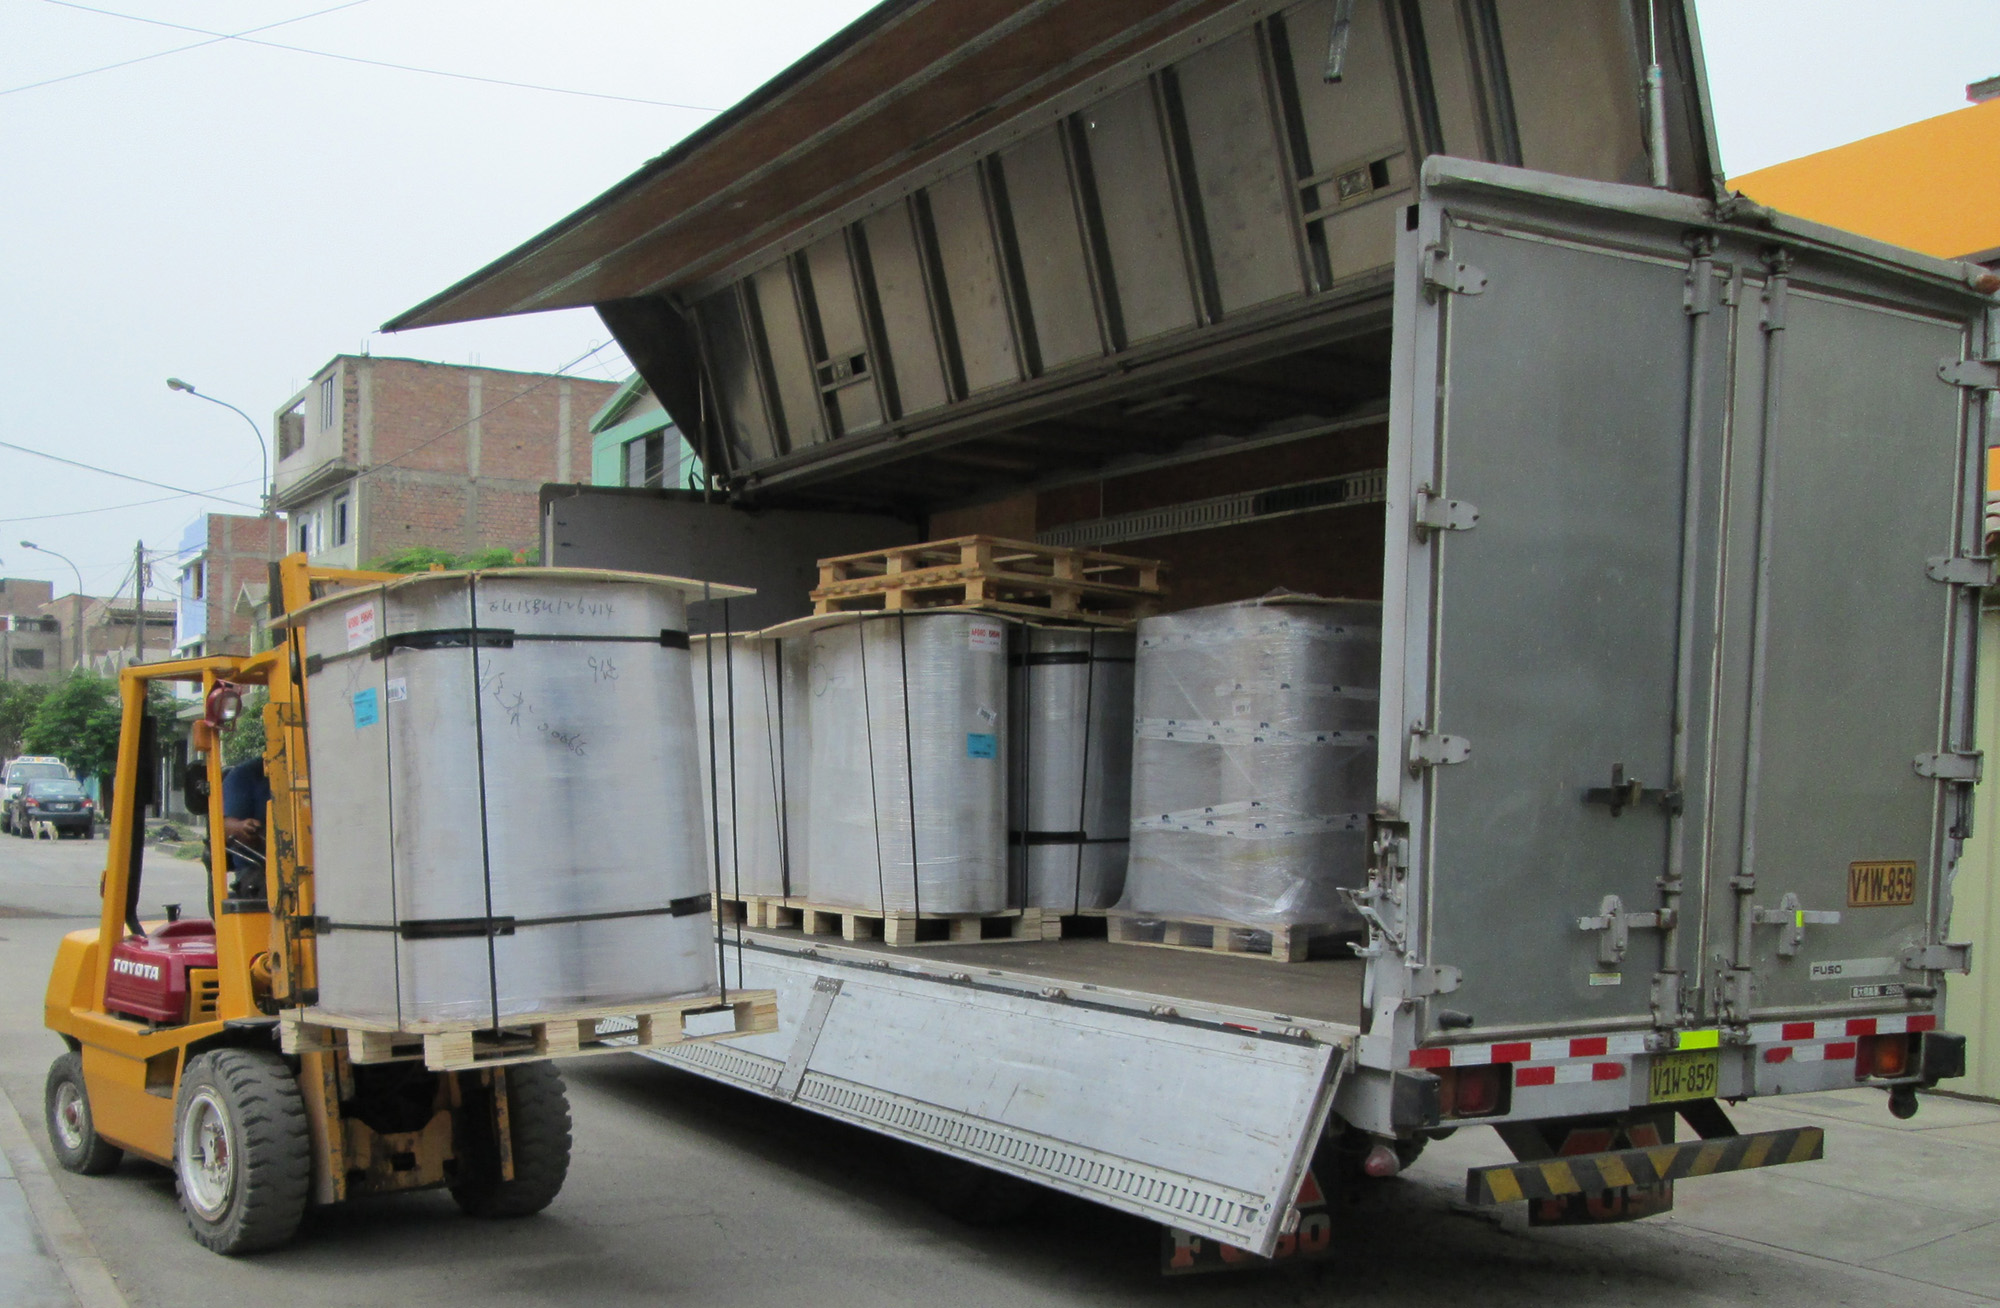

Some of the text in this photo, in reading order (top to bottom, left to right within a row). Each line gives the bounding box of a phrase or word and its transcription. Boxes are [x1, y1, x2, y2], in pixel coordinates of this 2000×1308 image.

[1851, 866, 1913, 902] V1W-859
[113, 958, 160, 980] TOYOTA
[1812, 964, 1842, 975] FUSO
[1653, 1063, 1715, 1096] V1W-859
